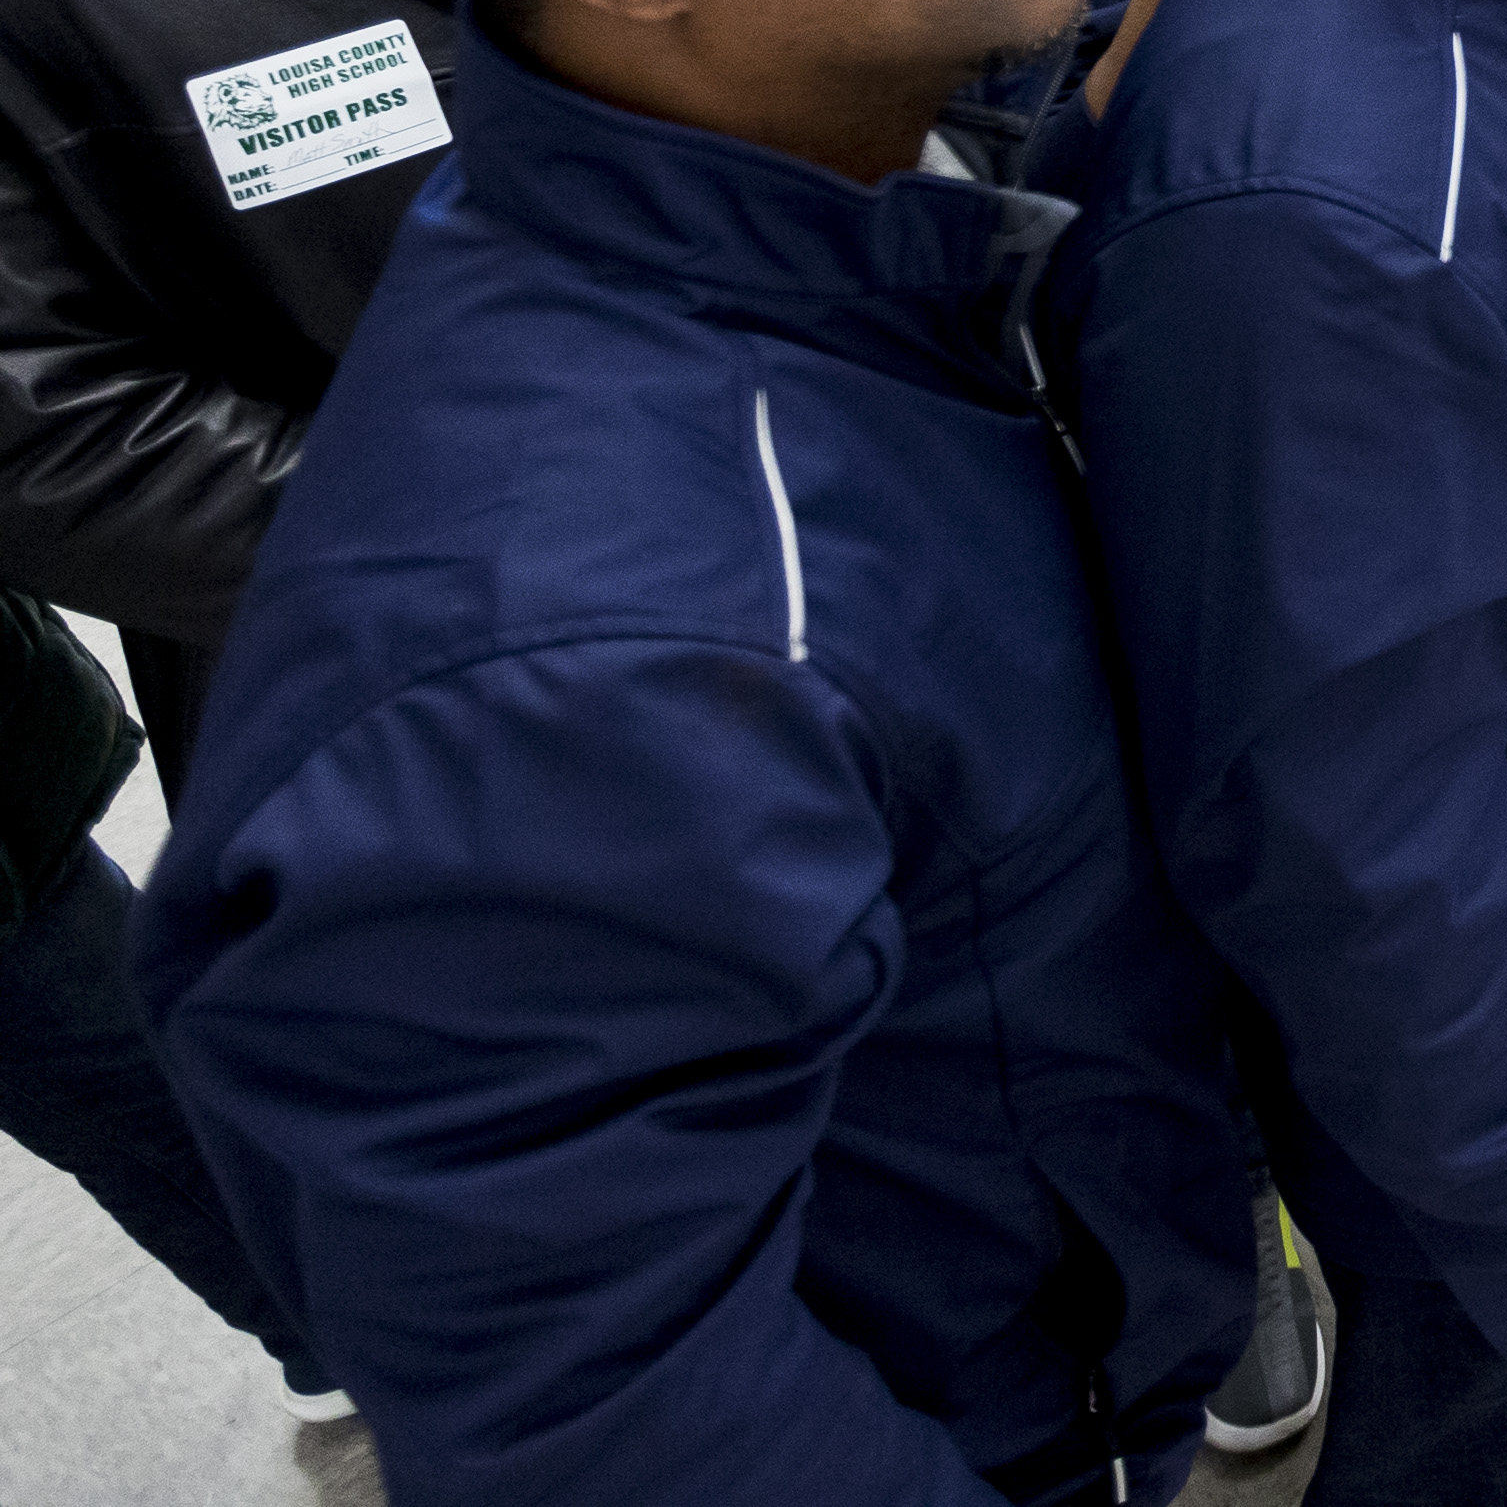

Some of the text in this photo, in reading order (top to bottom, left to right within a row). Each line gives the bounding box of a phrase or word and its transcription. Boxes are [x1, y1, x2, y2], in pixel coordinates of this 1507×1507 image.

[268, 33, 406, 85] LOUISA COUNTY
[287, 52, 408, 98] HIGH SCHOOL
[237, 88, 408, 155] VISITOR PASS
[227, 164, 275, 185] NAME:
[232, 146, 385, 201] DATE: TIME:
